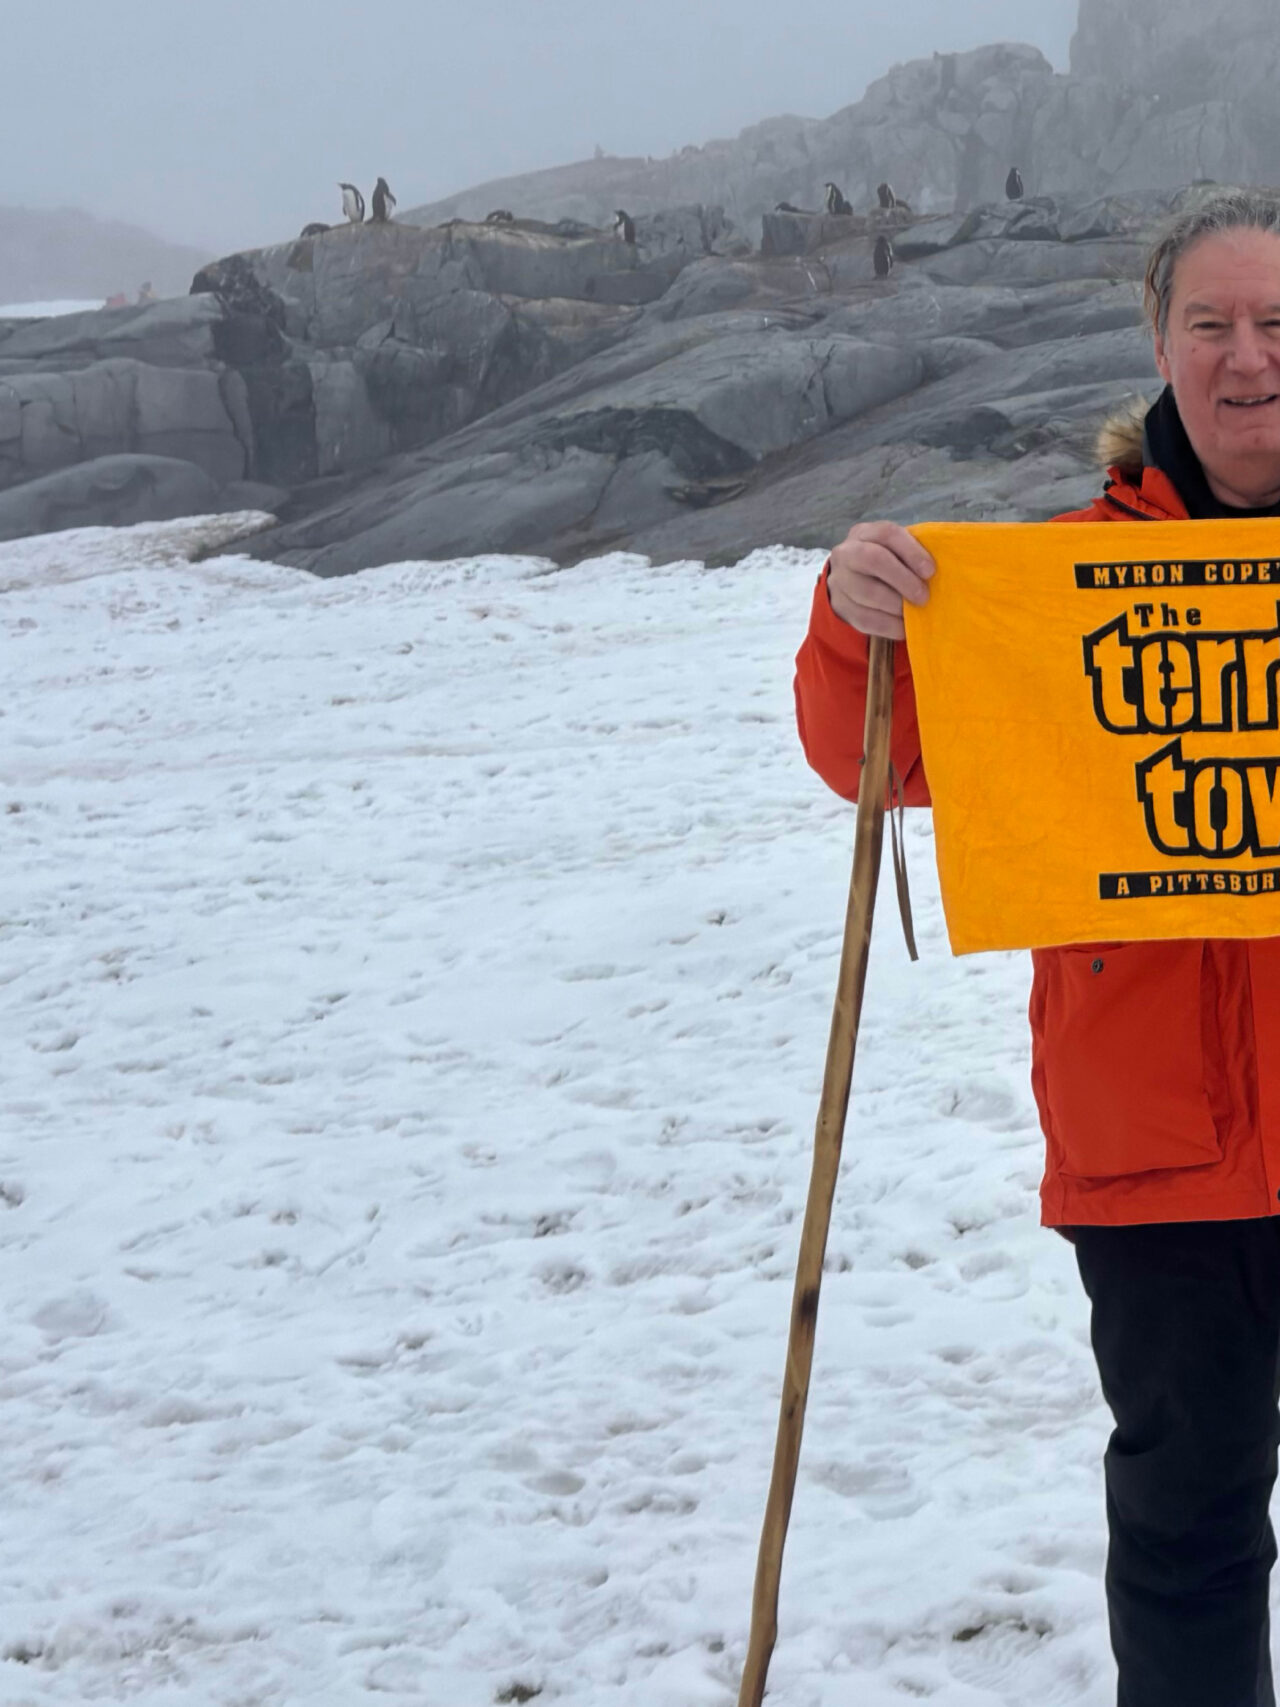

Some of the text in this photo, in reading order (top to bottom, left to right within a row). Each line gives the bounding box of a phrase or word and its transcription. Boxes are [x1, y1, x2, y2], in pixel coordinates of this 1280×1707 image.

[1094, 564, 1184, 587] MYRON
[1134, 602, 1202, 628] The
[1116, 876, 1130, 896] A
